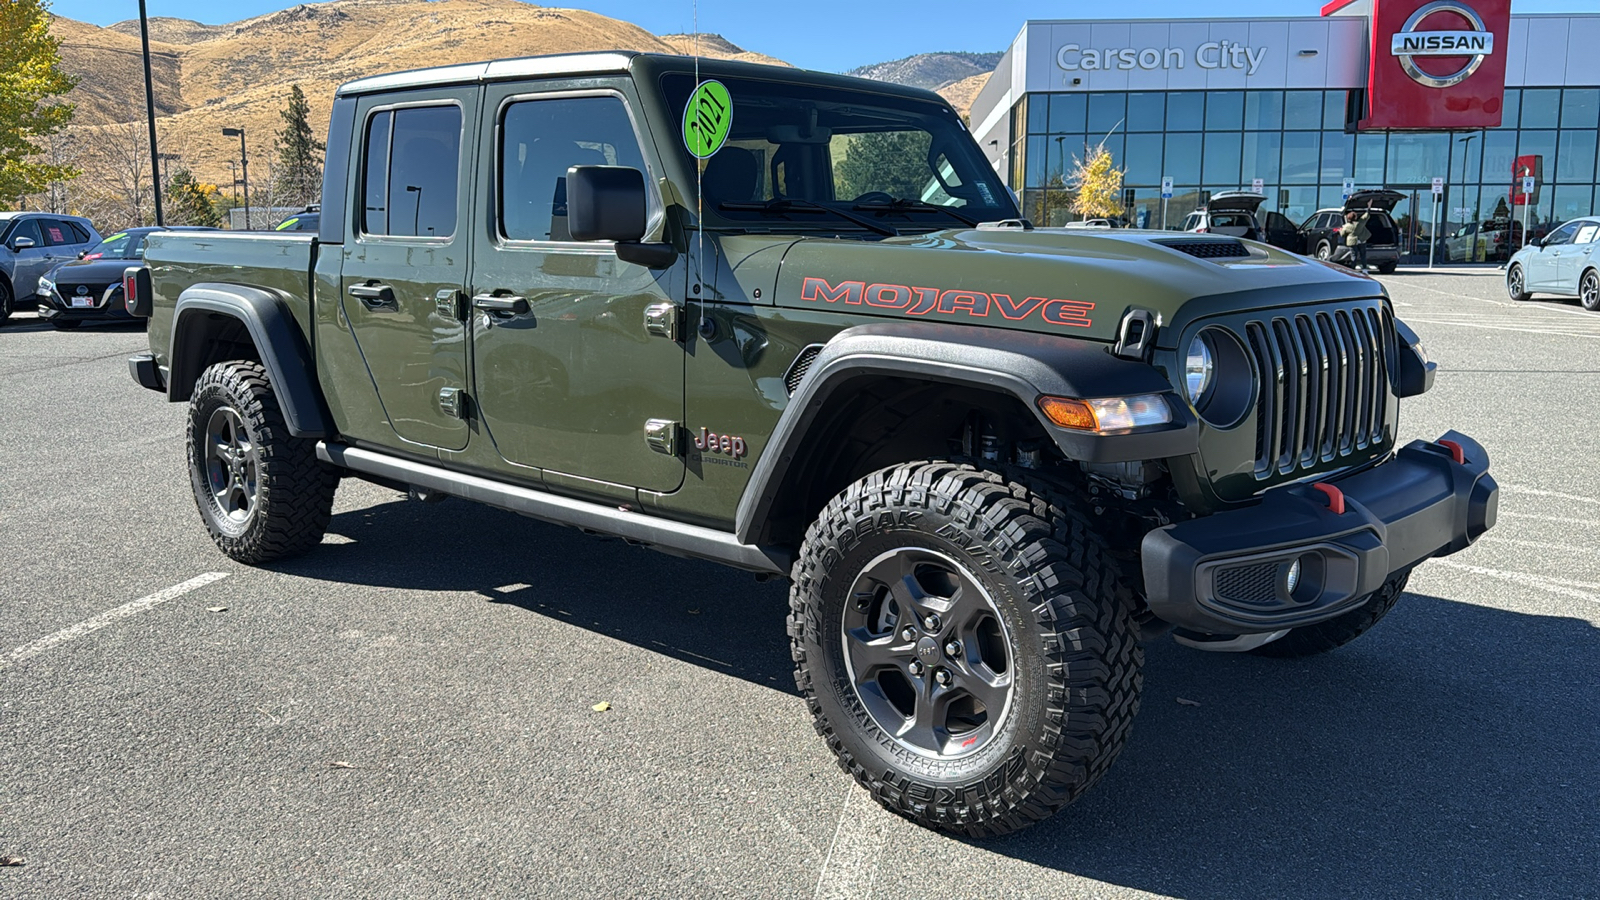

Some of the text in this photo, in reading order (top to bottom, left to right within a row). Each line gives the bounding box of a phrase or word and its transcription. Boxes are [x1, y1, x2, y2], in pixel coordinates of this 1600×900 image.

[1056, 39, 1268, 76] Carson City
[1403, 36, 1485, 50] NISSAN
[690, 86, 725, 150] 2021
[801, 276, 1096, 328] MOJAVE
[691, 454, 749, 469] GLADIATOR
[694, 426, 745, 459] Jeep
[804, 509, 924, 648] WILDPEAK
[935, 522, 1007, 576] M/T
[881, 744, 1027, 805] FALKEN
